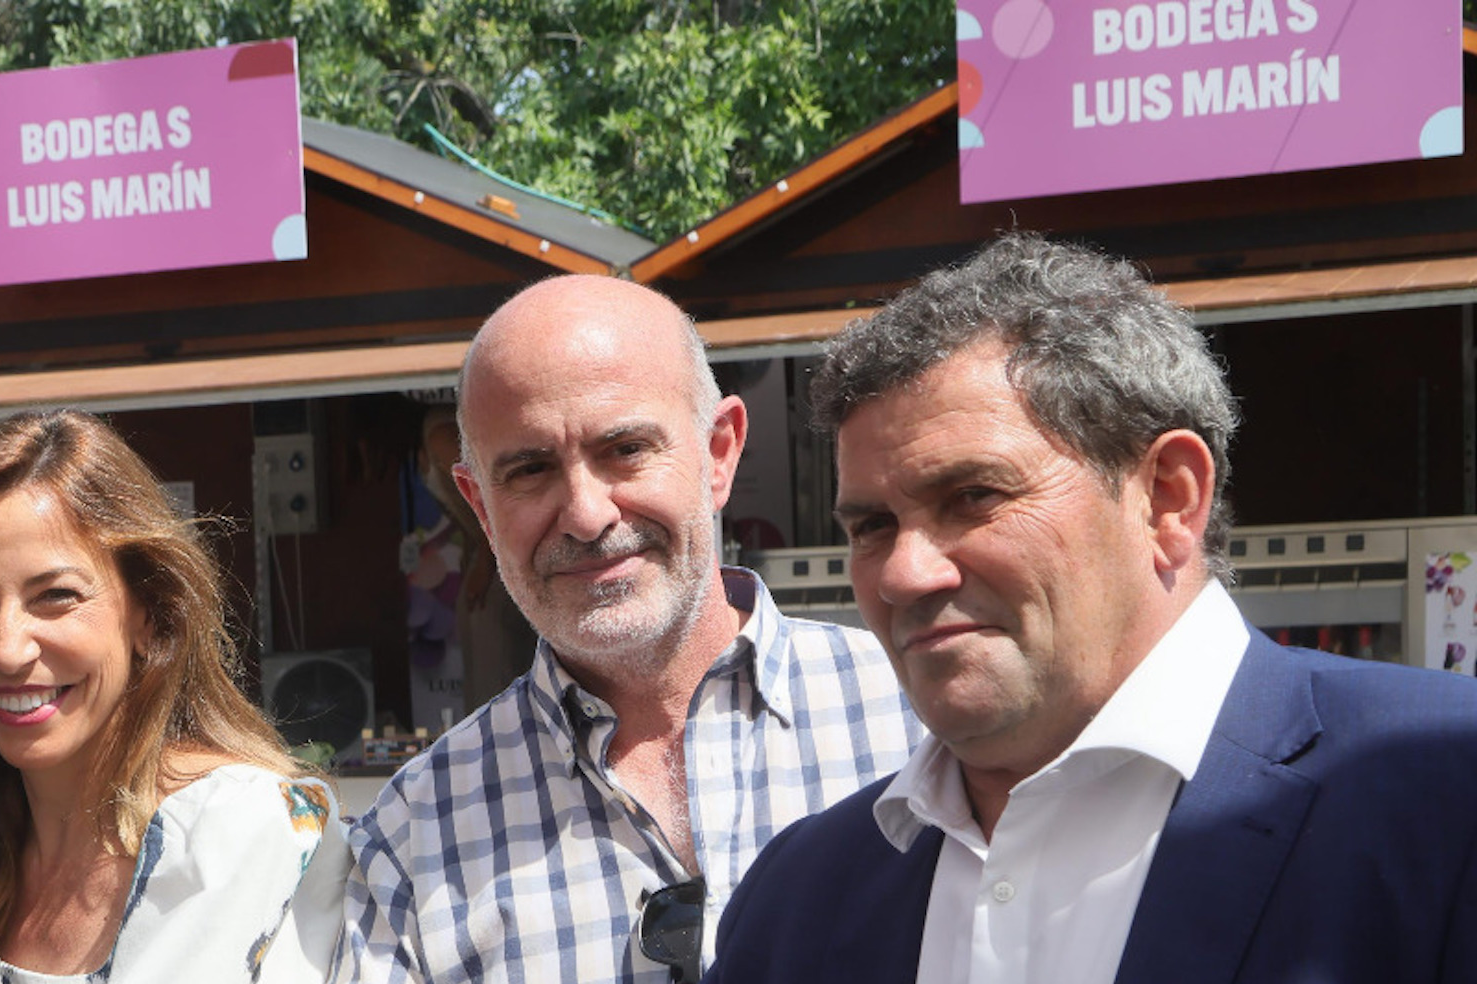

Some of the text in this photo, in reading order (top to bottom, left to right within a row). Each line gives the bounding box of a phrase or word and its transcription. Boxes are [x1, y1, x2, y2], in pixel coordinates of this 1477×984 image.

[1093, 0, 1318, 55] BODEGA S
[1073, 48, 1340, 128] LUIS MARÍN
[20, 105, 192, 164] BODEGA S
[7, 160, 211, 228] LUIS MARÍN
